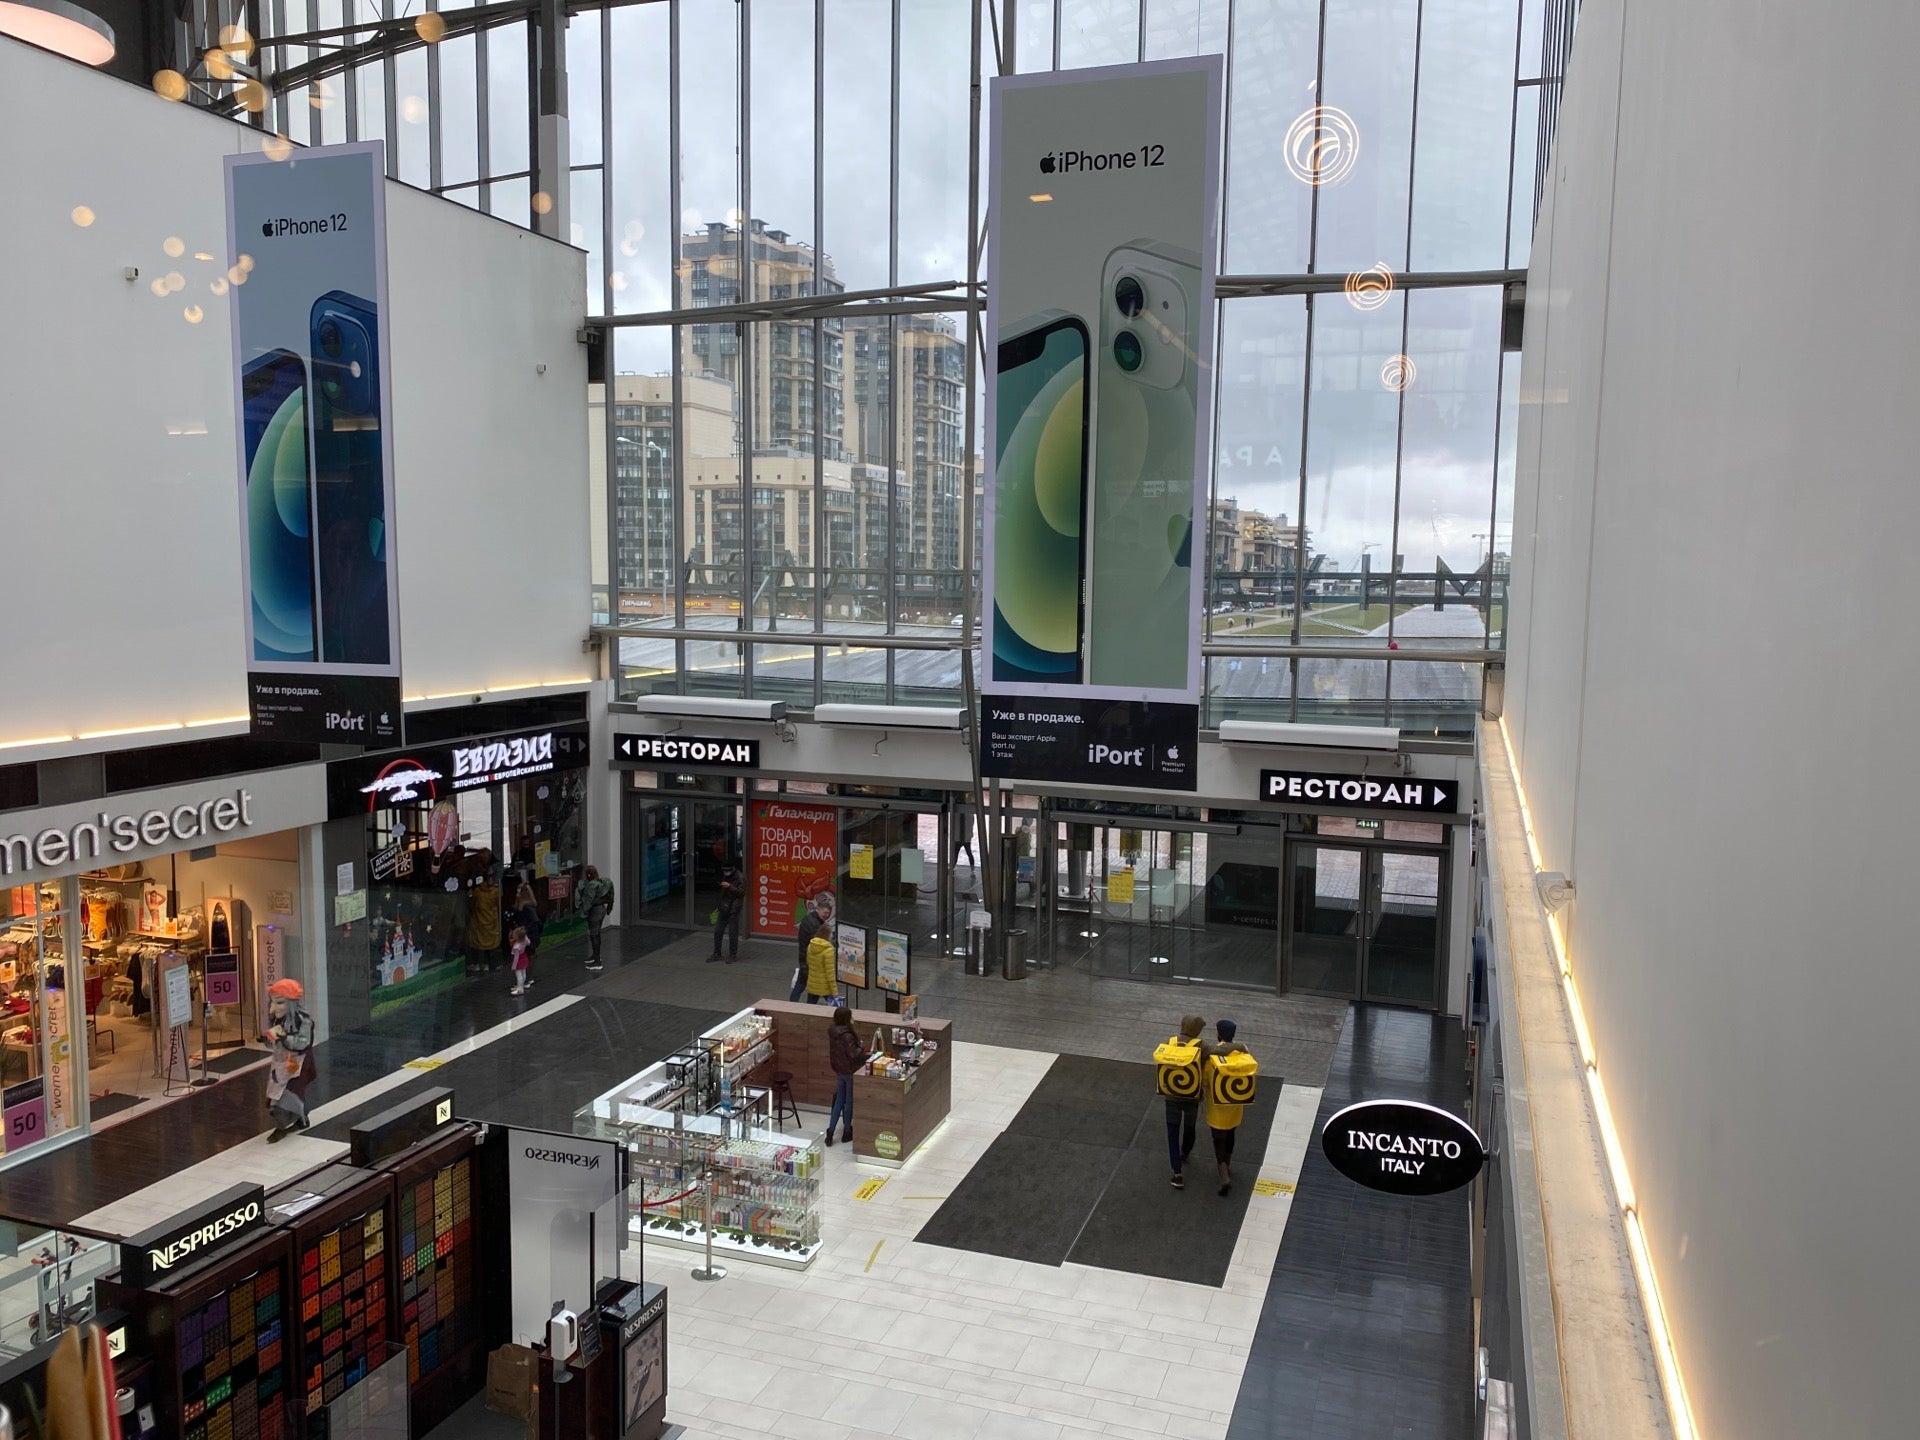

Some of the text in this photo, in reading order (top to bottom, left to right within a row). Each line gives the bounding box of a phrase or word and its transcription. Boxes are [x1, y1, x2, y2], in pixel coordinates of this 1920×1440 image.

[1058, 144, 1165, 173] iPhone 12
[275, 213, 347, 236] iPhone 12
[256, 685, 273, 695] Уже
[282, 686, 322, 696] продаже.
[326, 711, 364, 731] iPort
[992, 709, 1085, 724] Уже в продаже.
[991, 732, 1007, 740] Ваш
[1008, 734, 1035, 742] эксперт
[991, 742, 1016, 750] iport.ru
[453, 733, 552, 777] ЕВРАЗИЯ
[638, 739, 750, 762] РЕСТОРАН
[1089, 744, 1142, 766] iPort
[1269, 776, 1422, 805] РЕСТОРАН
[769, 805, 834, 824] Галамарт
[760, 827, 812, 844] ТОВАРЫ
[760, 842, 834, 861] ДЛЯ ДОМА
[213, 981, 231, 993] 50
[13, 1112, 36, 1136] 50
[1347, 1130, 1461, 1159] INCANTO
[1381, 1157, 1425, 1175] ITALY
[147, 1202, 258, 1272] NESPRESSO
[624, 1299, 663, 1339] NESPRESSO
